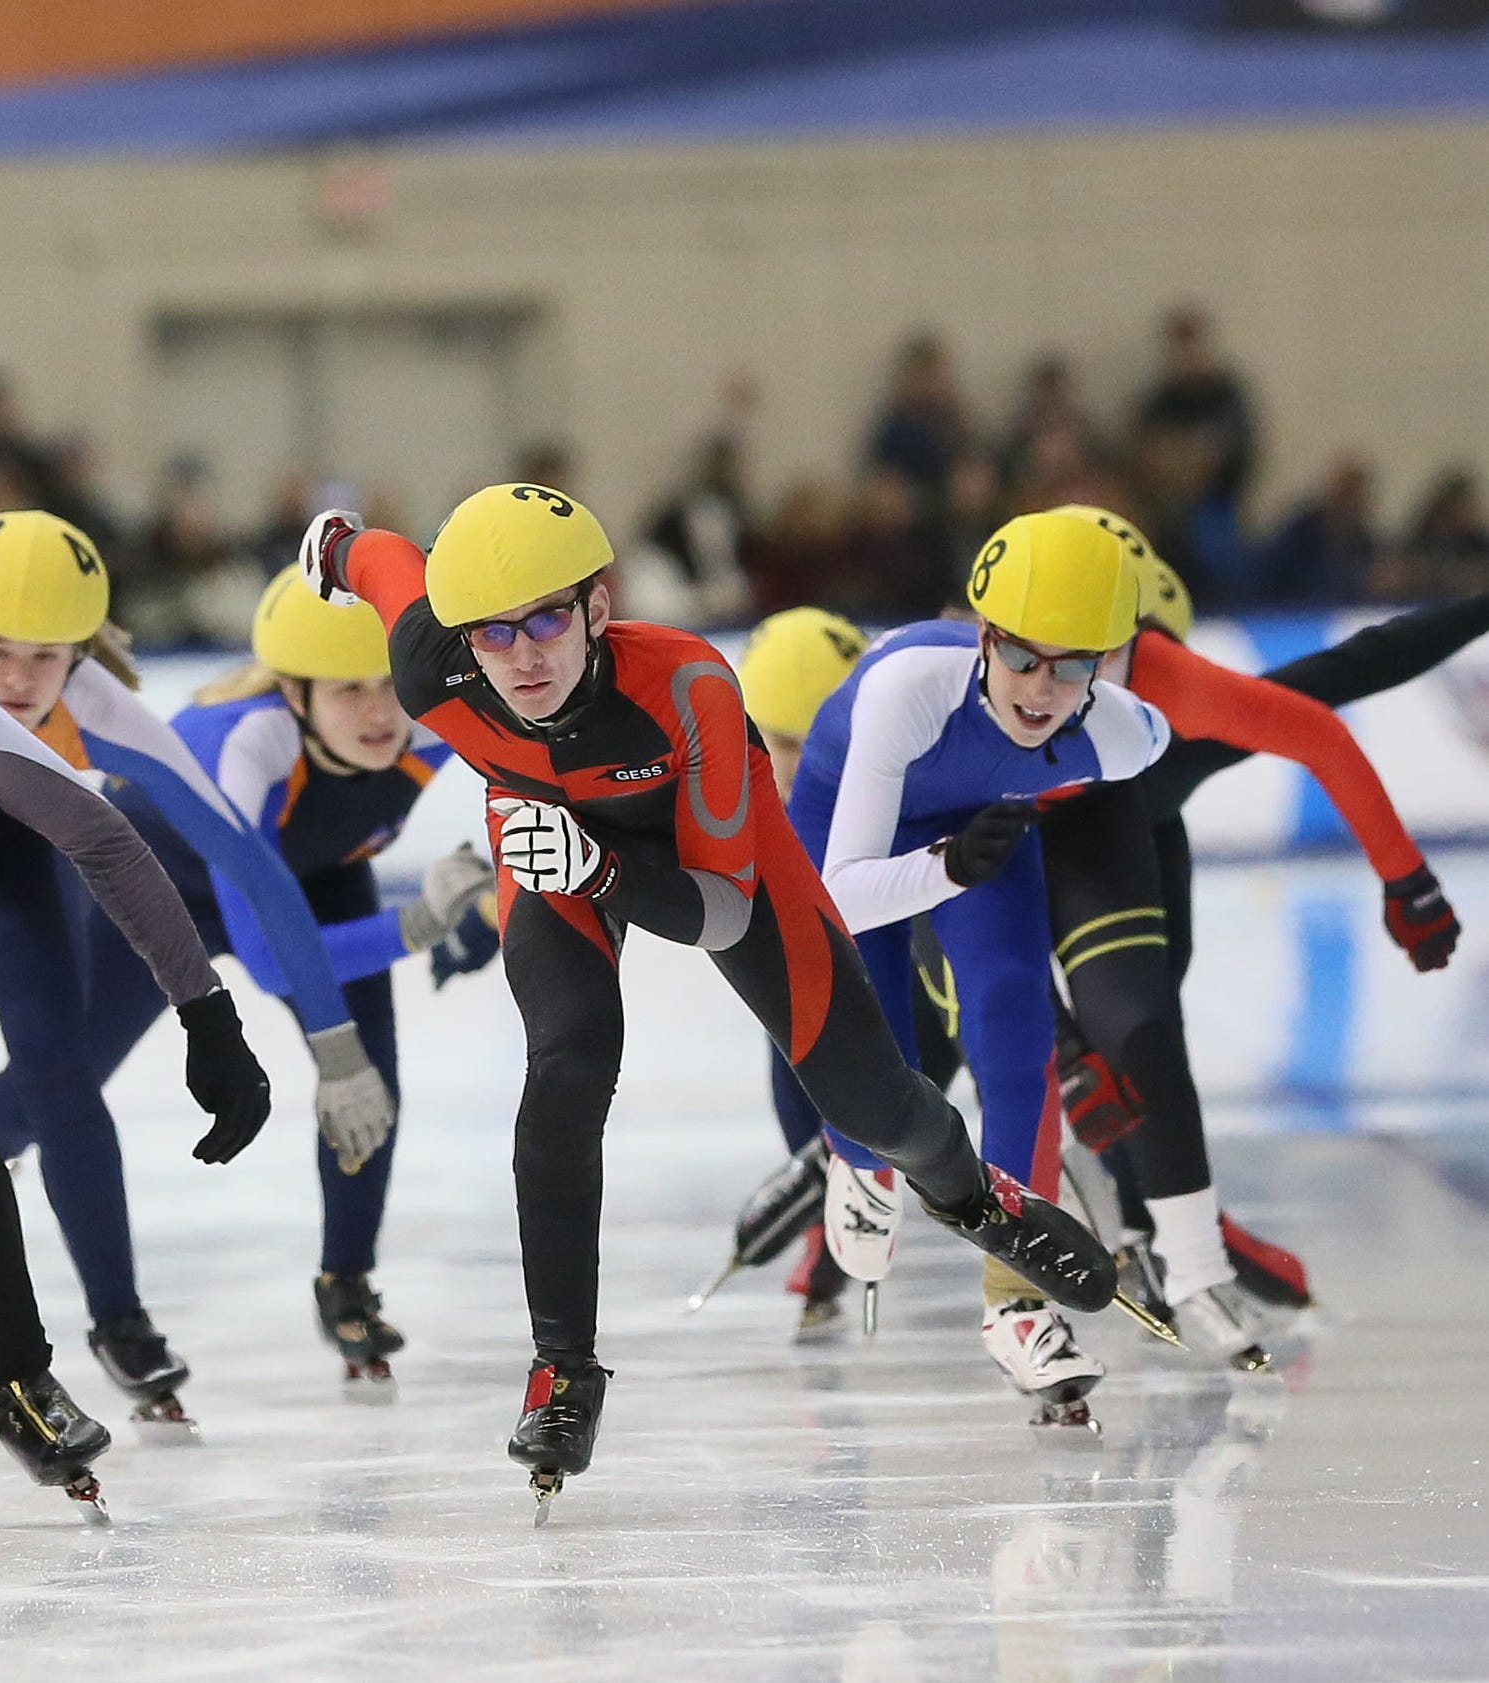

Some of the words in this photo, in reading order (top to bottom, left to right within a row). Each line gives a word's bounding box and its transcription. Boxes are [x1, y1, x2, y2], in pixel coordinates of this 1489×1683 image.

[511, 486, 574, 517] 3
[62, 533, 100, 575] 4
[973, 540, 1006, 600] 8
[615, 765, 663, 781] GESS
